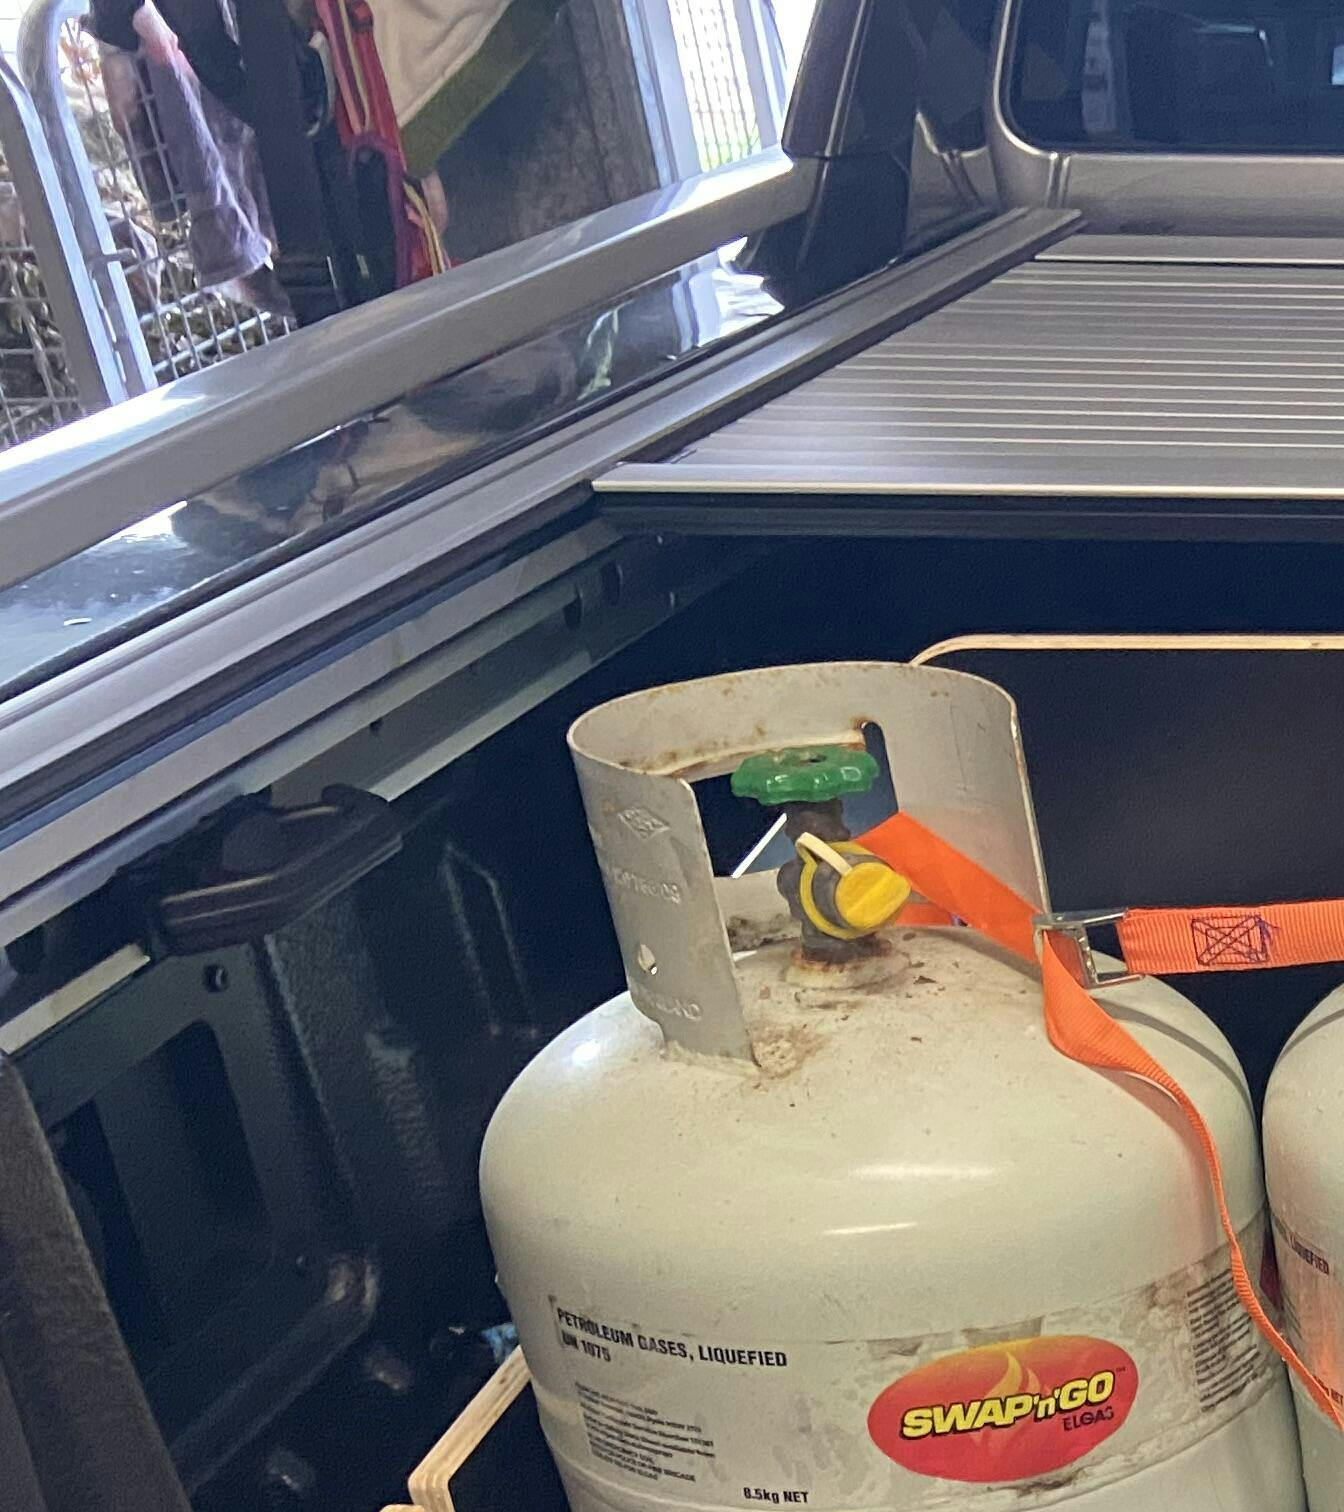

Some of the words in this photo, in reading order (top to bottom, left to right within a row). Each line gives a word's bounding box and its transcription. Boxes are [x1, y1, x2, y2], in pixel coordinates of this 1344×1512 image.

[557, 1307, 635, 1348] PETROLEUM
[638, 1334, 694, 1362] GASES,
[698, 1344, 788, 1367] LIQUEFIED
[561, 1330, 578, 1351] UN
[580, 1338, 612, 1363] 1075
[1063, 1406, 1115, 1432] ELGAS
[783, 1490, 809, 1503] NET
